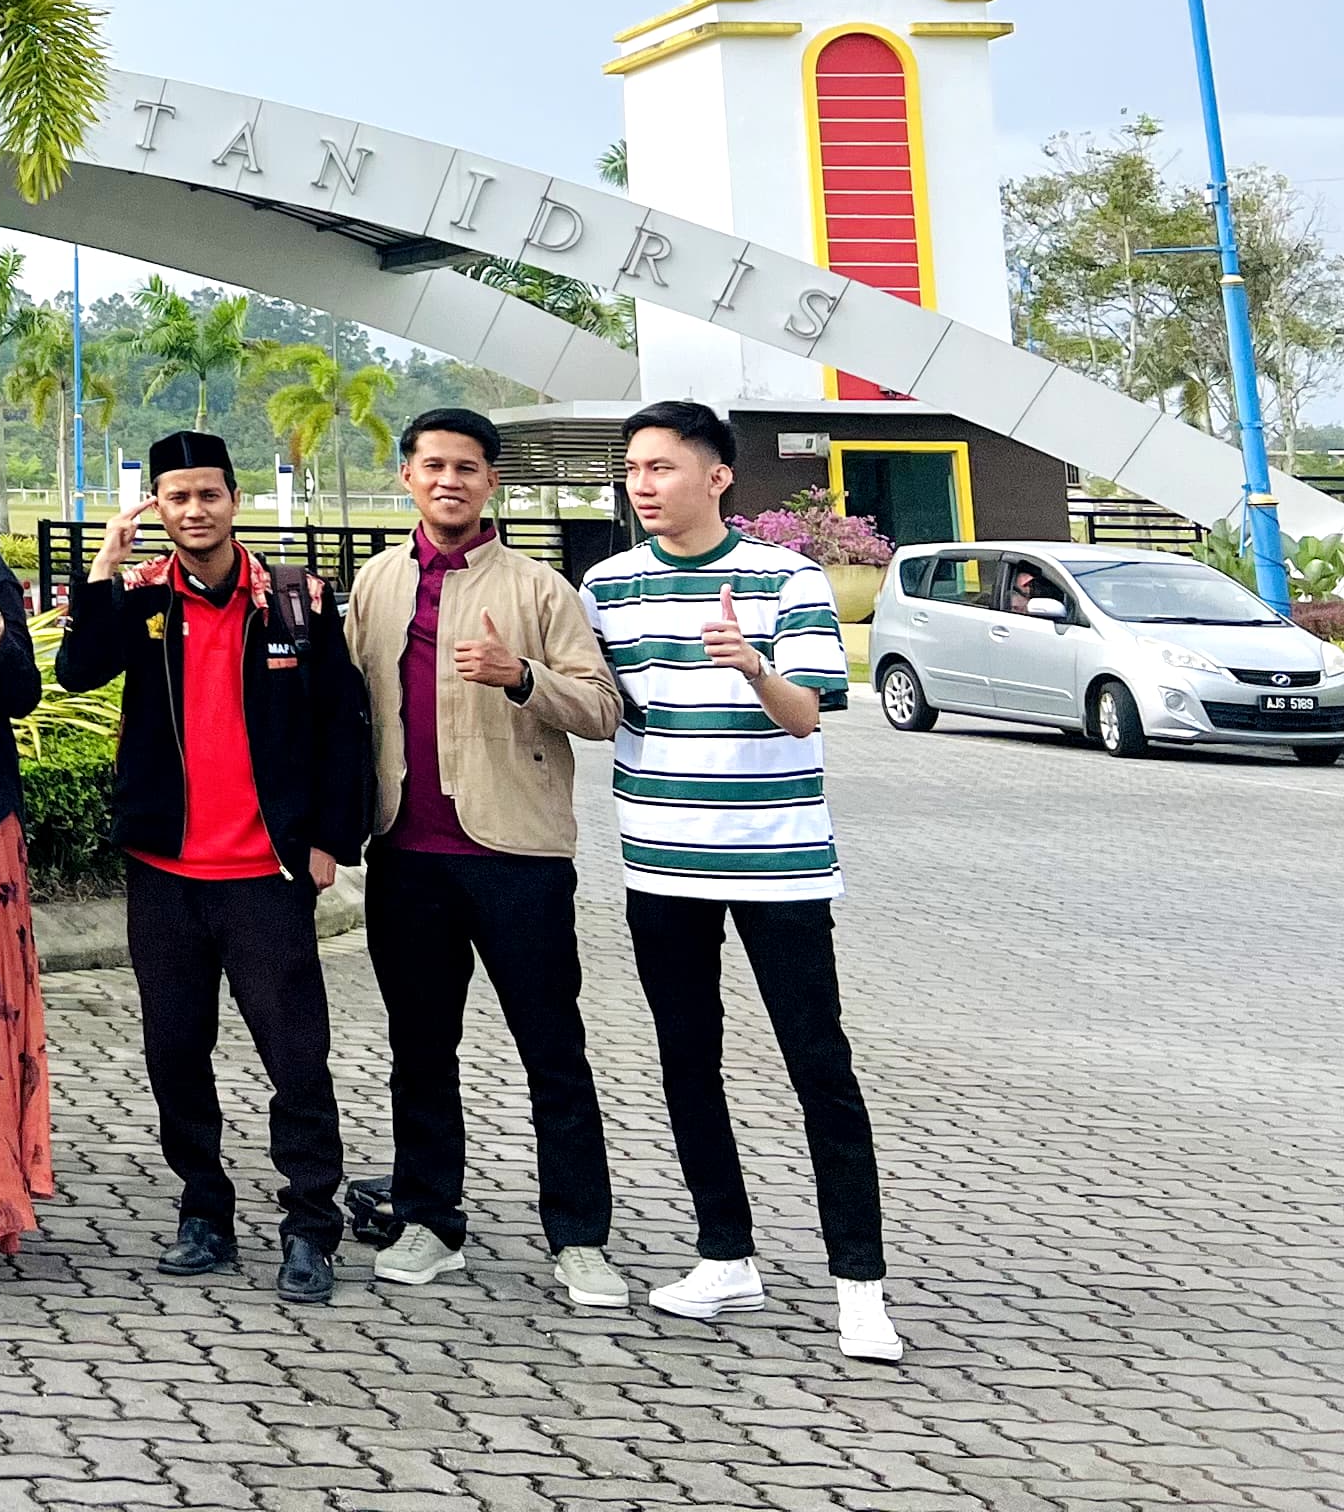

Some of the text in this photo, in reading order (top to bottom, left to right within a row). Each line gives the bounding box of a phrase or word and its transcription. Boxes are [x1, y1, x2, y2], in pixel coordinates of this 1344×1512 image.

[450, 170, 838, 340] IDRIS
[1266, 696, 1314, 710] AJS 5189
